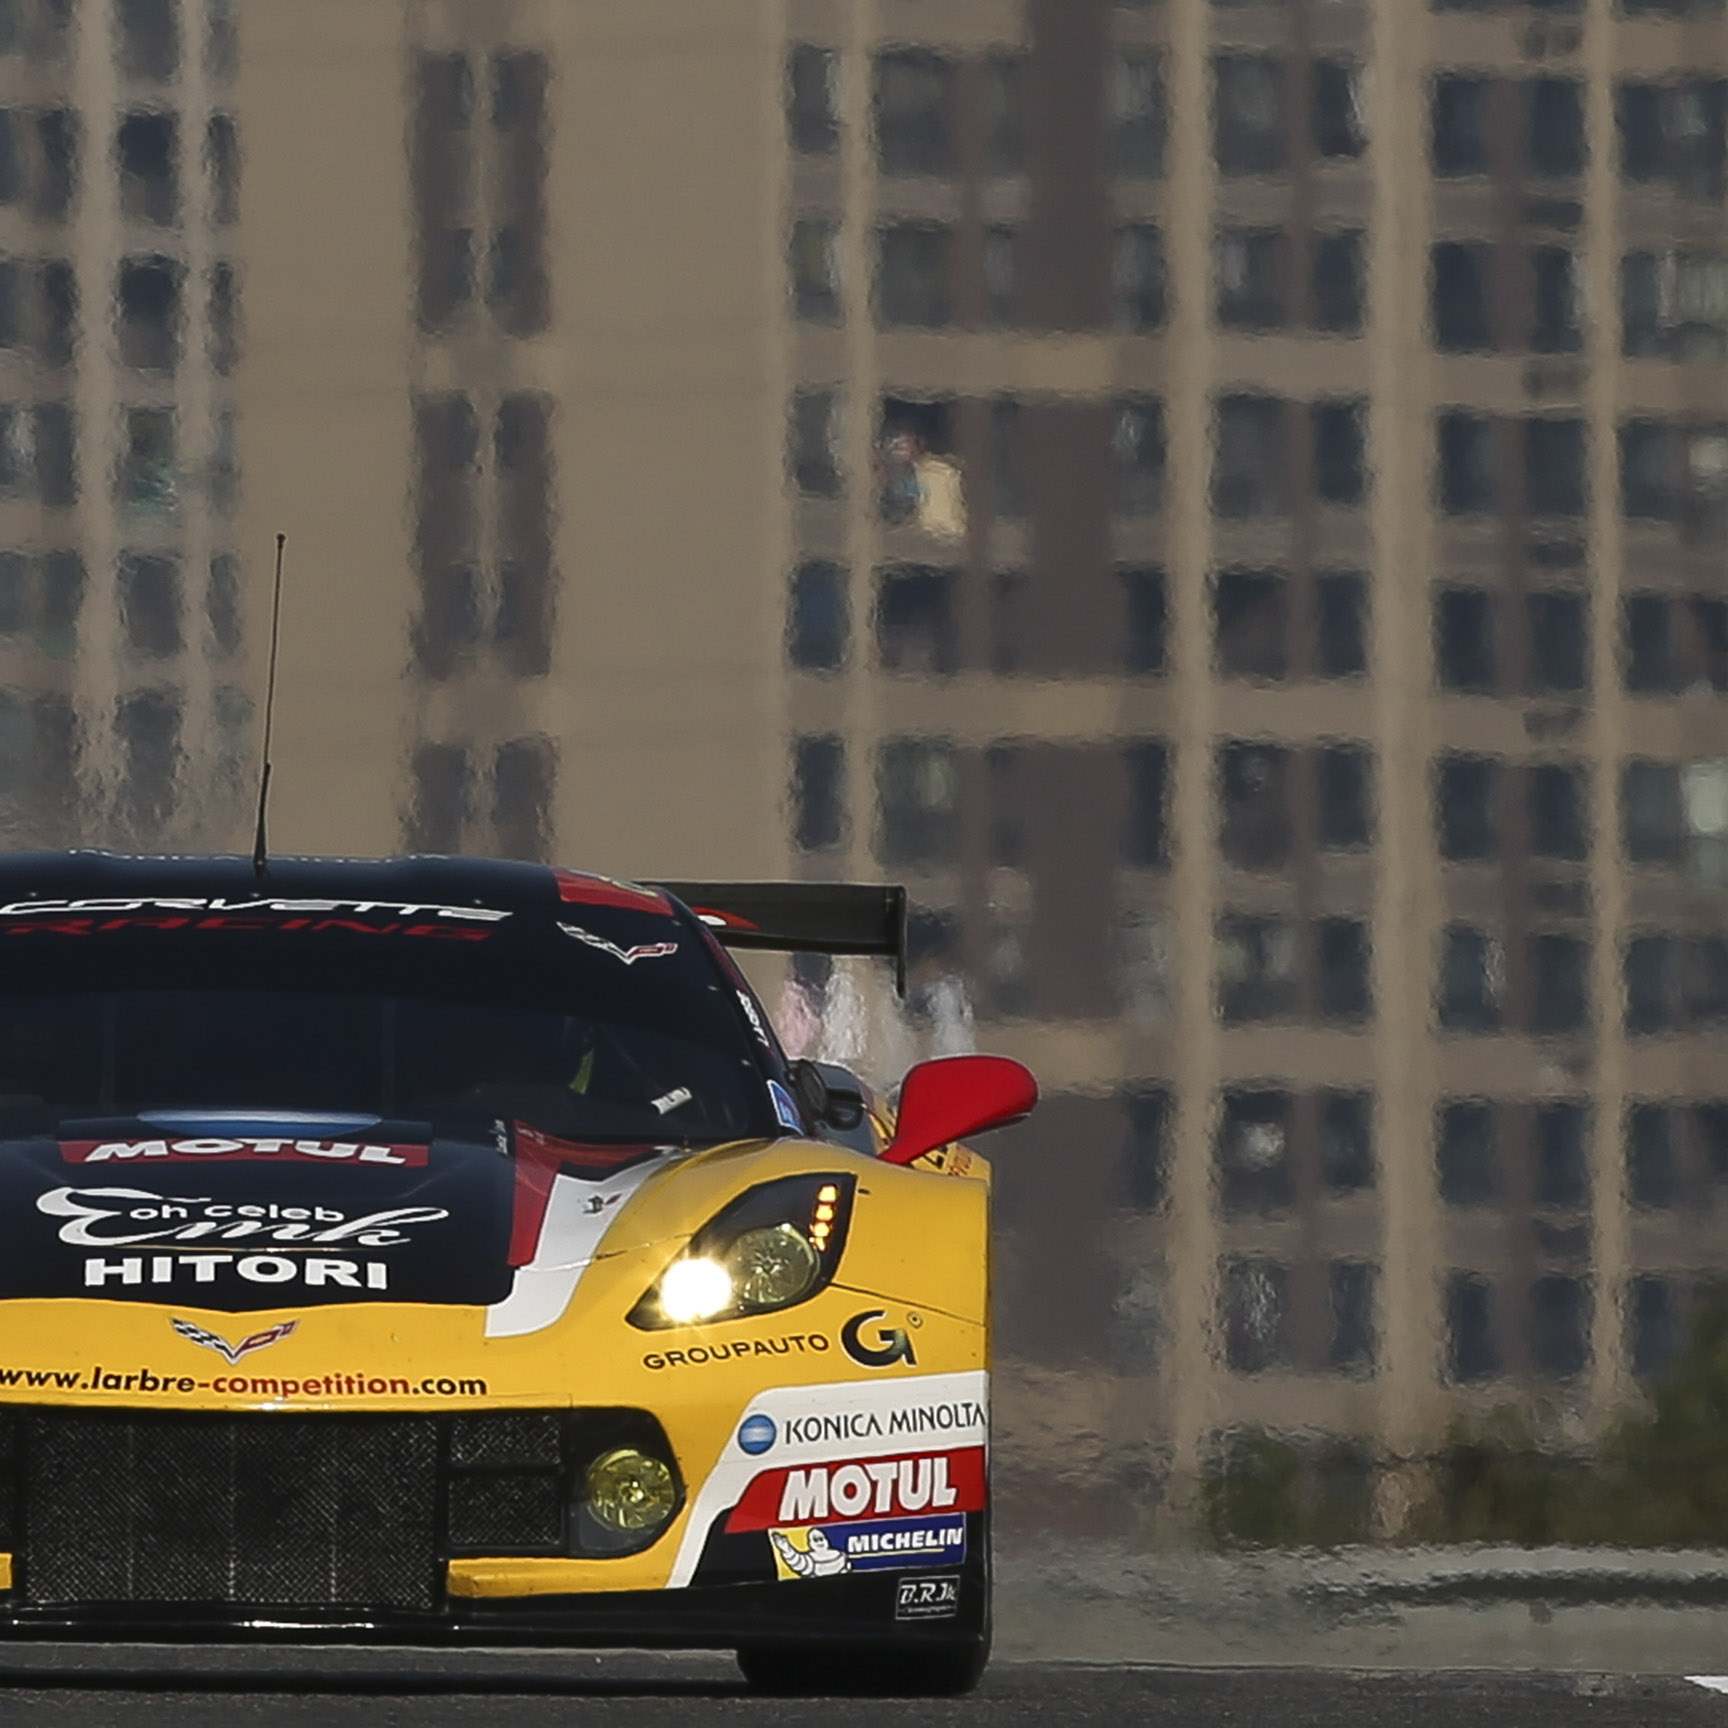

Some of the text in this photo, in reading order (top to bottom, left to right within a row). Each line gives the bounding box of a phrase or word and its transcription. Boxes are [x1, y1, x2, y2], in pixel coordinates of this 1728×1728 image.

[84, 1139, 408, 1164] MOTUL
[129, 1203, 344, 1223] oh celeb
[83, 1255, 388, 1290] HITORI
[643, 1333, 830, 1371] GROUPAUTO
[785, 1402, 987, 1445] KONICA MINOLTA
[778, 1456, 958, 1522] MOTUL
[847, 1527, 964, 1553] MICHELIN
